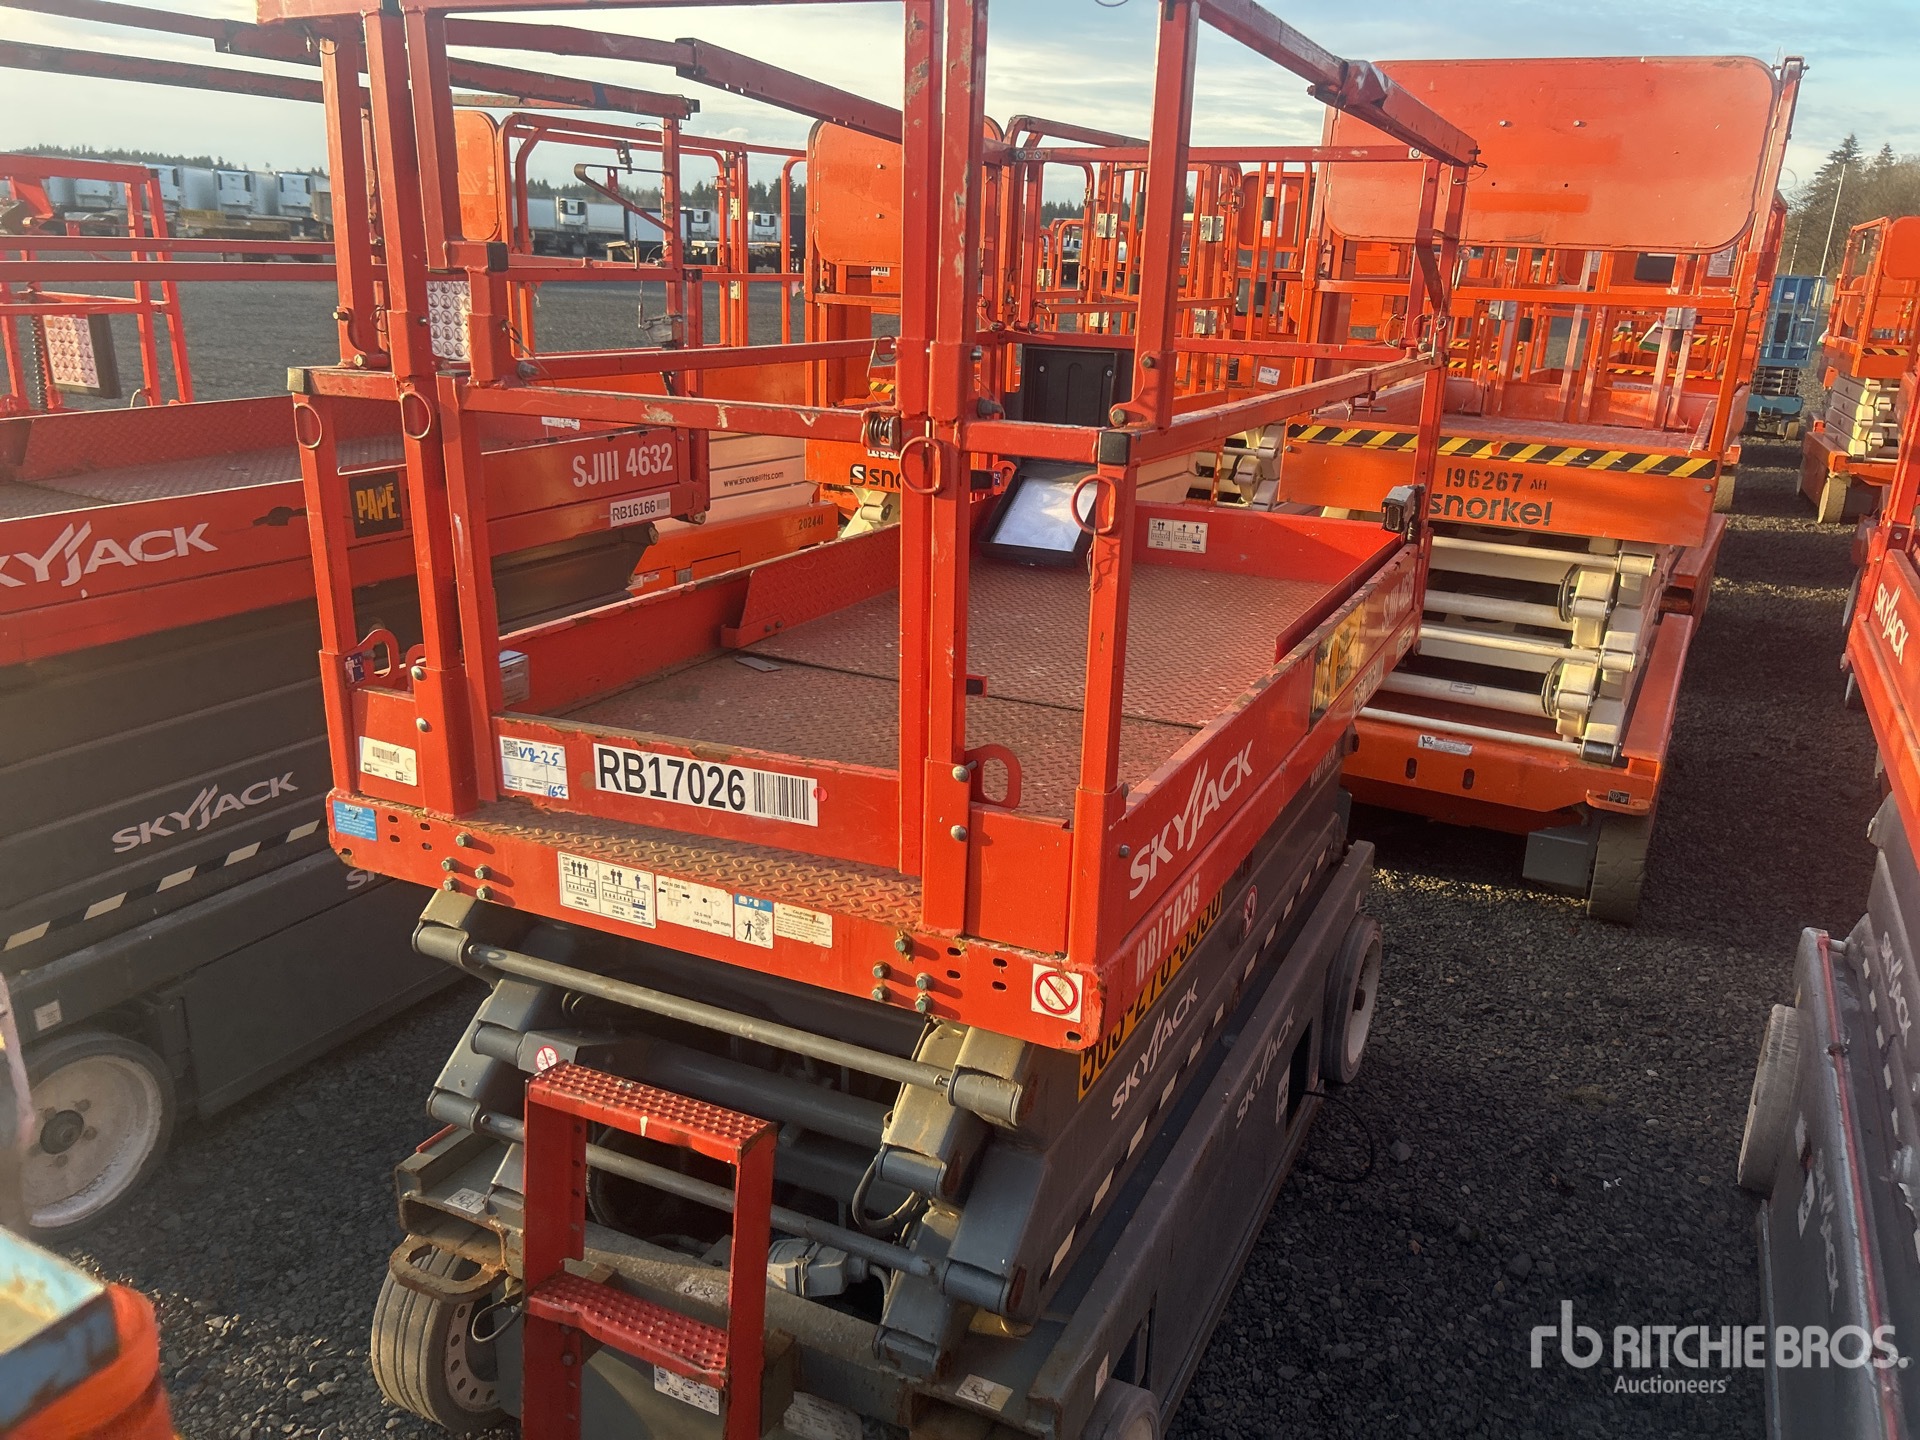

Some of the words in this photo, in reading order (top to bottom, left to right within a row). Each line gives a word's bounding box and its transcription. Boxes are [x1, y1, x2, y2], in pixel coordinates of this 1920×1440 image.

[626, 442, 673, 477] 4632
[1445, 467, 1524, 493] 196267
[612, 500, 656, 521] RB16166
[798, 514, 824, 531] 202441
[1429, 493, 1553, 527] snorkel
[1874, 582, 1909, 665] SKYJACK
[598, 747, 746, 811] RB17026
[112, 771, 299, 853] SKYJACK
[1129, 738, 1253, 900] SKYJACK
[1135, 872, 1200, 987] RB17026
[1111, 976, 1199, 1120] SKYJACK
